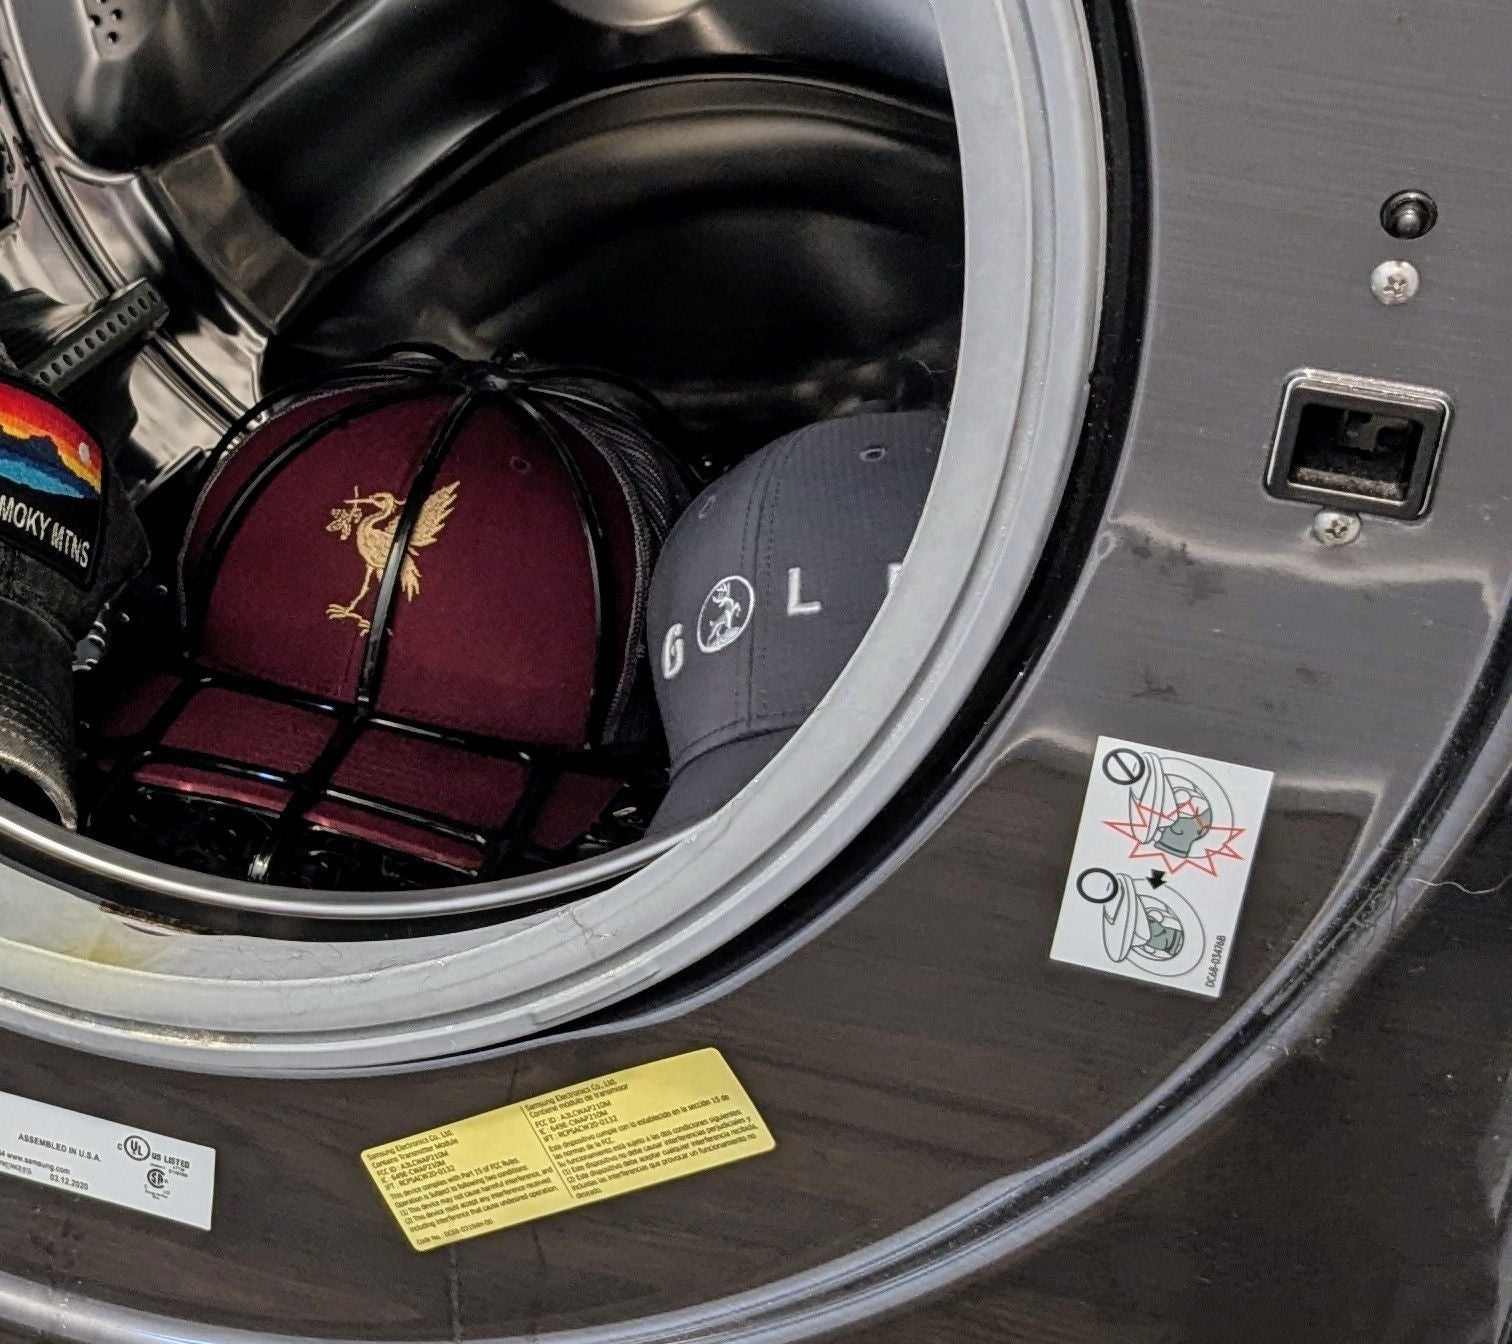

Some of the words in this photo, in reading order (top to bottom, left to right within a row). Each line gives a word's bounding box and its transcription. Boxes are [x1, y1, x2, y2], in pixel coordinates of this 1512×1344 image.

[50, 522, 90, 569] MTNS
[18, 1133, 67, 1153] ASSEMBLED
[69, 1146, 76, 1156] IN
